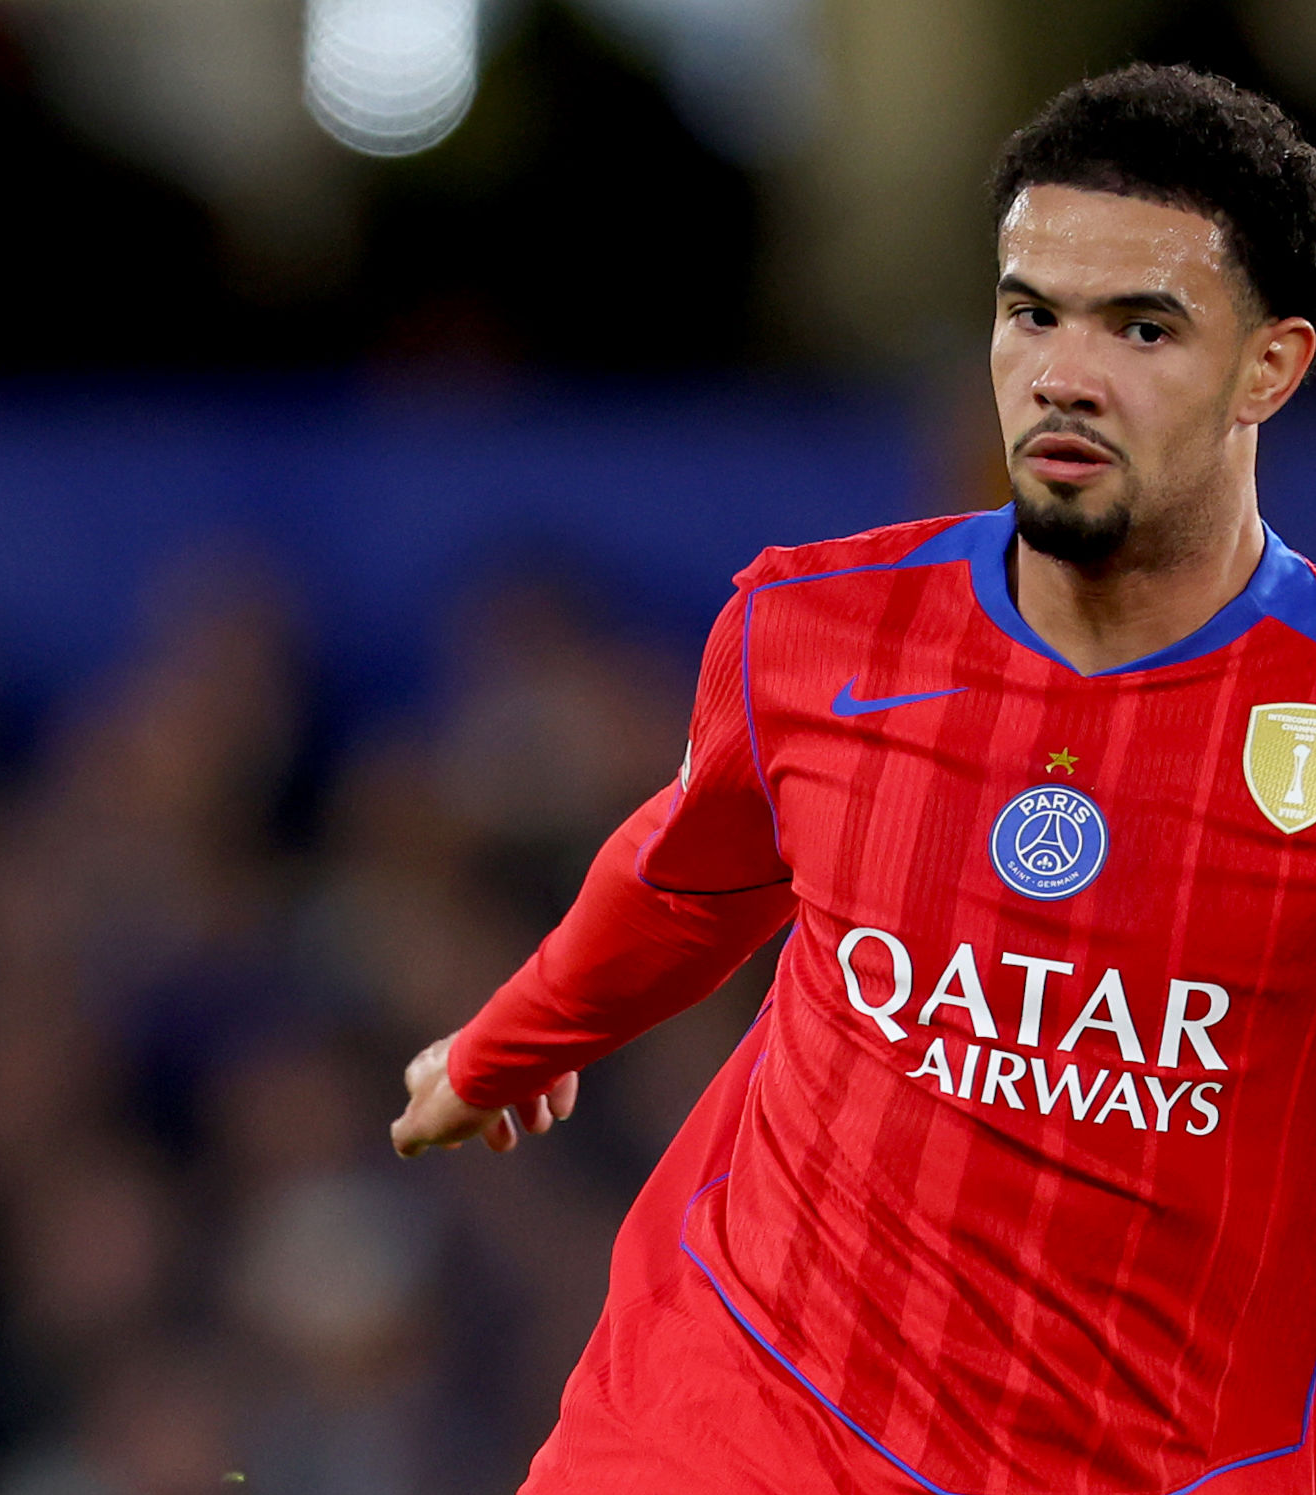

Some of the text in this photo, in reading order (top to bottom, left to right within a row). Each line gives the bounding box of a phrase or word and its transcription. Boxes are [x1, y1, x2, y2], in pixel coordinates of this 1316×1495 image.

[1018, 793, 1091, 824] PARIS
[1278, 807, 1307, 820] FIFA
[1006, 860, 1080, 889] SAINT GERMAIN
[836, 926, 1231, 1071] QATAR
[904, 1037, 1224, 1137] AIRWAYS
